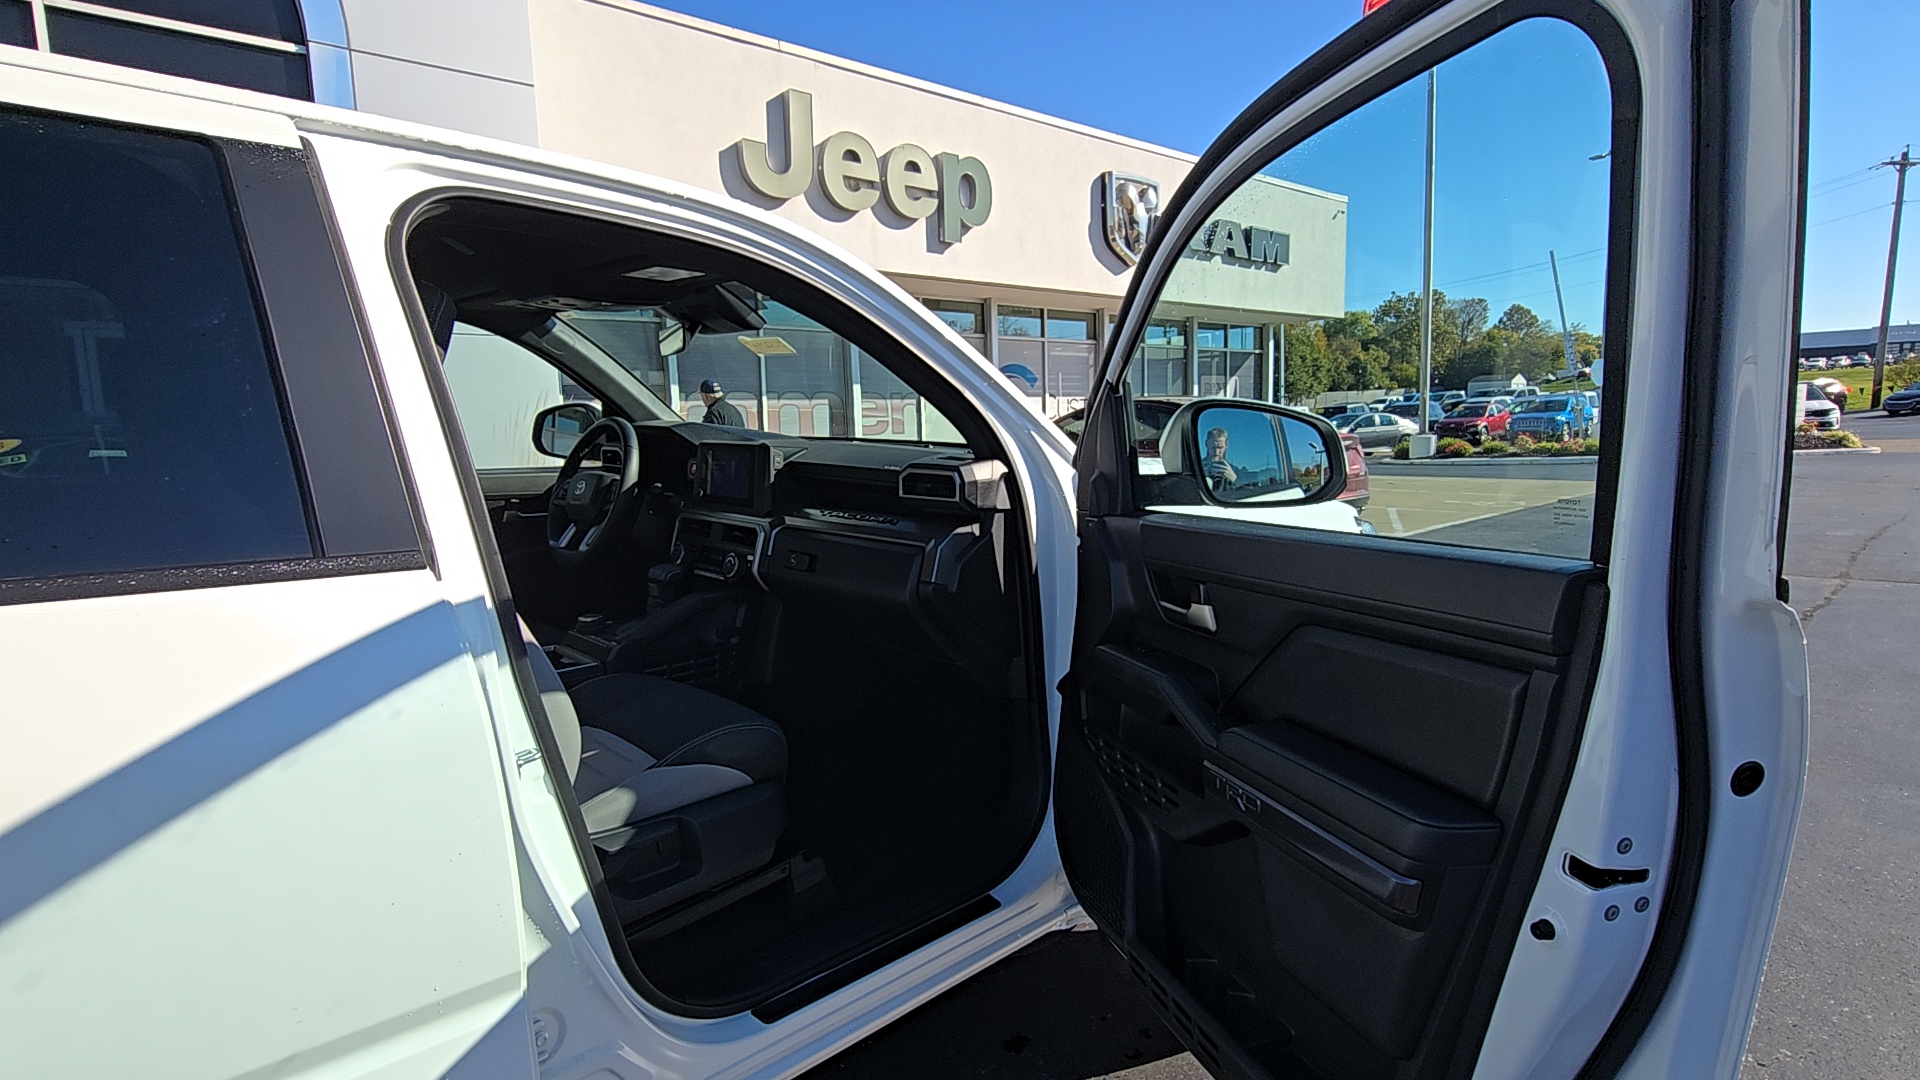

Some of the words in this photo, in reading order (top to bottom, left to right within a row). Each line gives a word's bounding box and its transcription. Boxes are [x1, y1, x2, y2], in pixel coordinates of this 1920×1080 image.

[737, 88, 992, 244] Jeep
[820, 509, 900, 526] TACOMA
[1210, 770, 1261, 812] TRD
